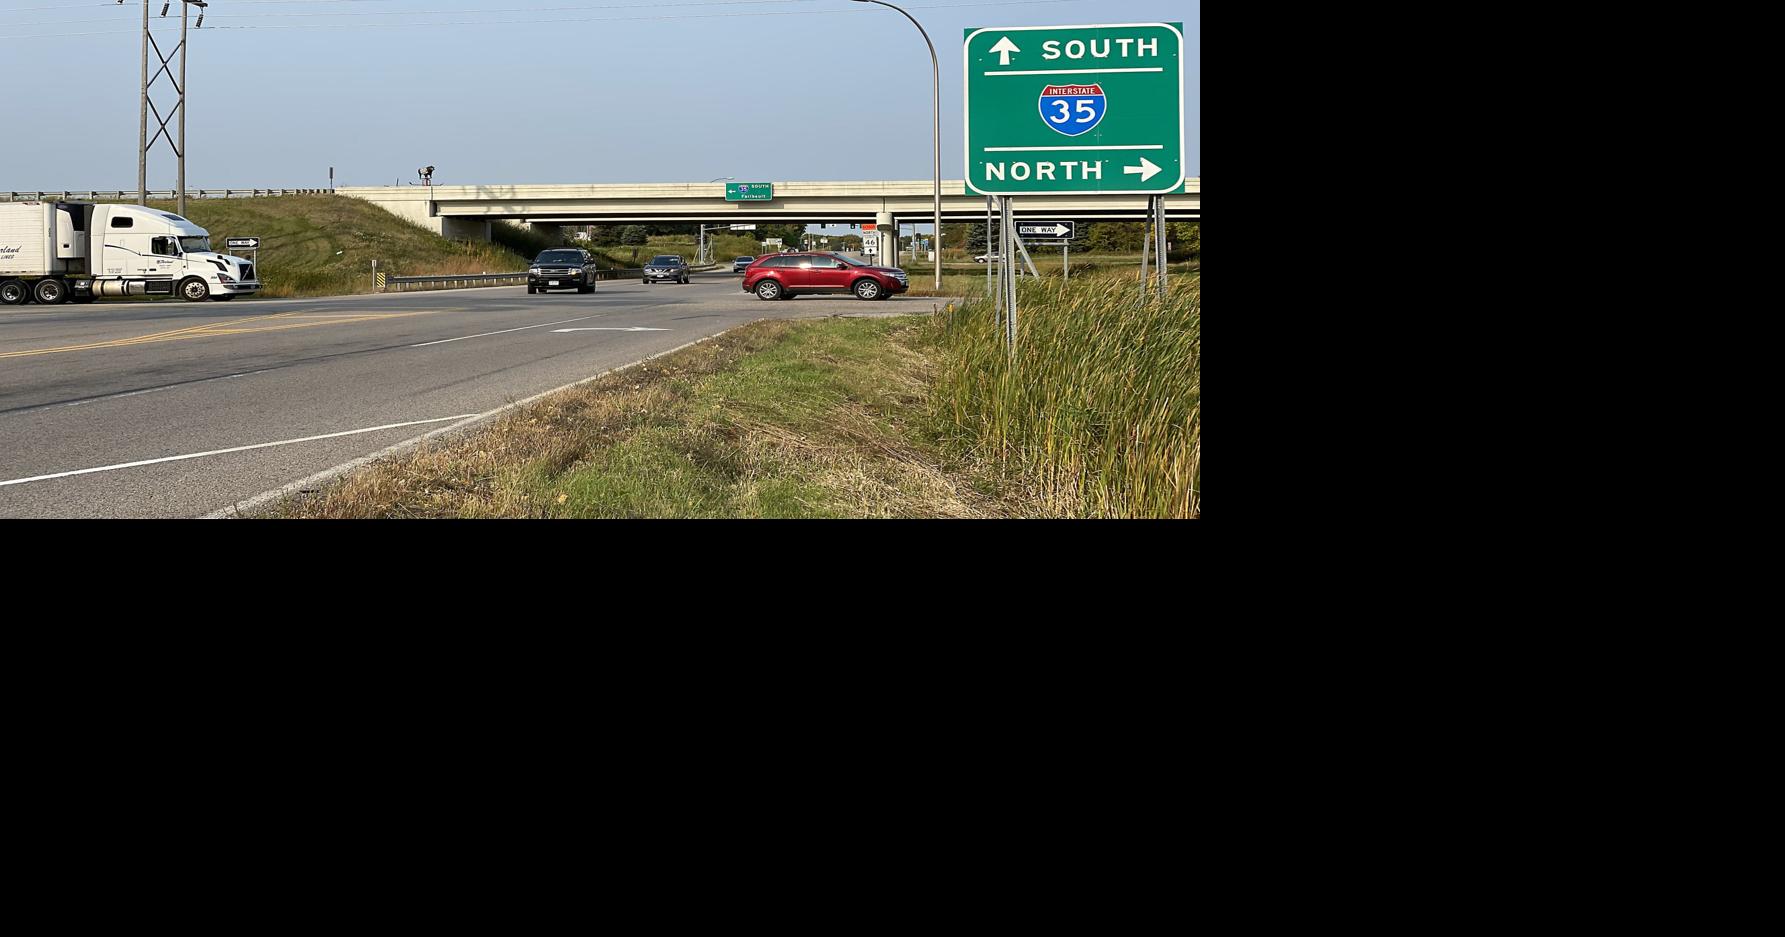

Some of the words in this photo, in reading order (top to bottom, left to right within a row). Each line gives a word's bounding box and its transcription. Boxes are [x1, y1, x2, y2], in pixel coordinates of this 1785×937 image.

[1042, 38, 1158, 60] SOUTH
[1049, 87, 1095, 95] INTERSTATE
[1050, 99, 1096, 124] 35
[985, 160, 1103, 181] NORTH
